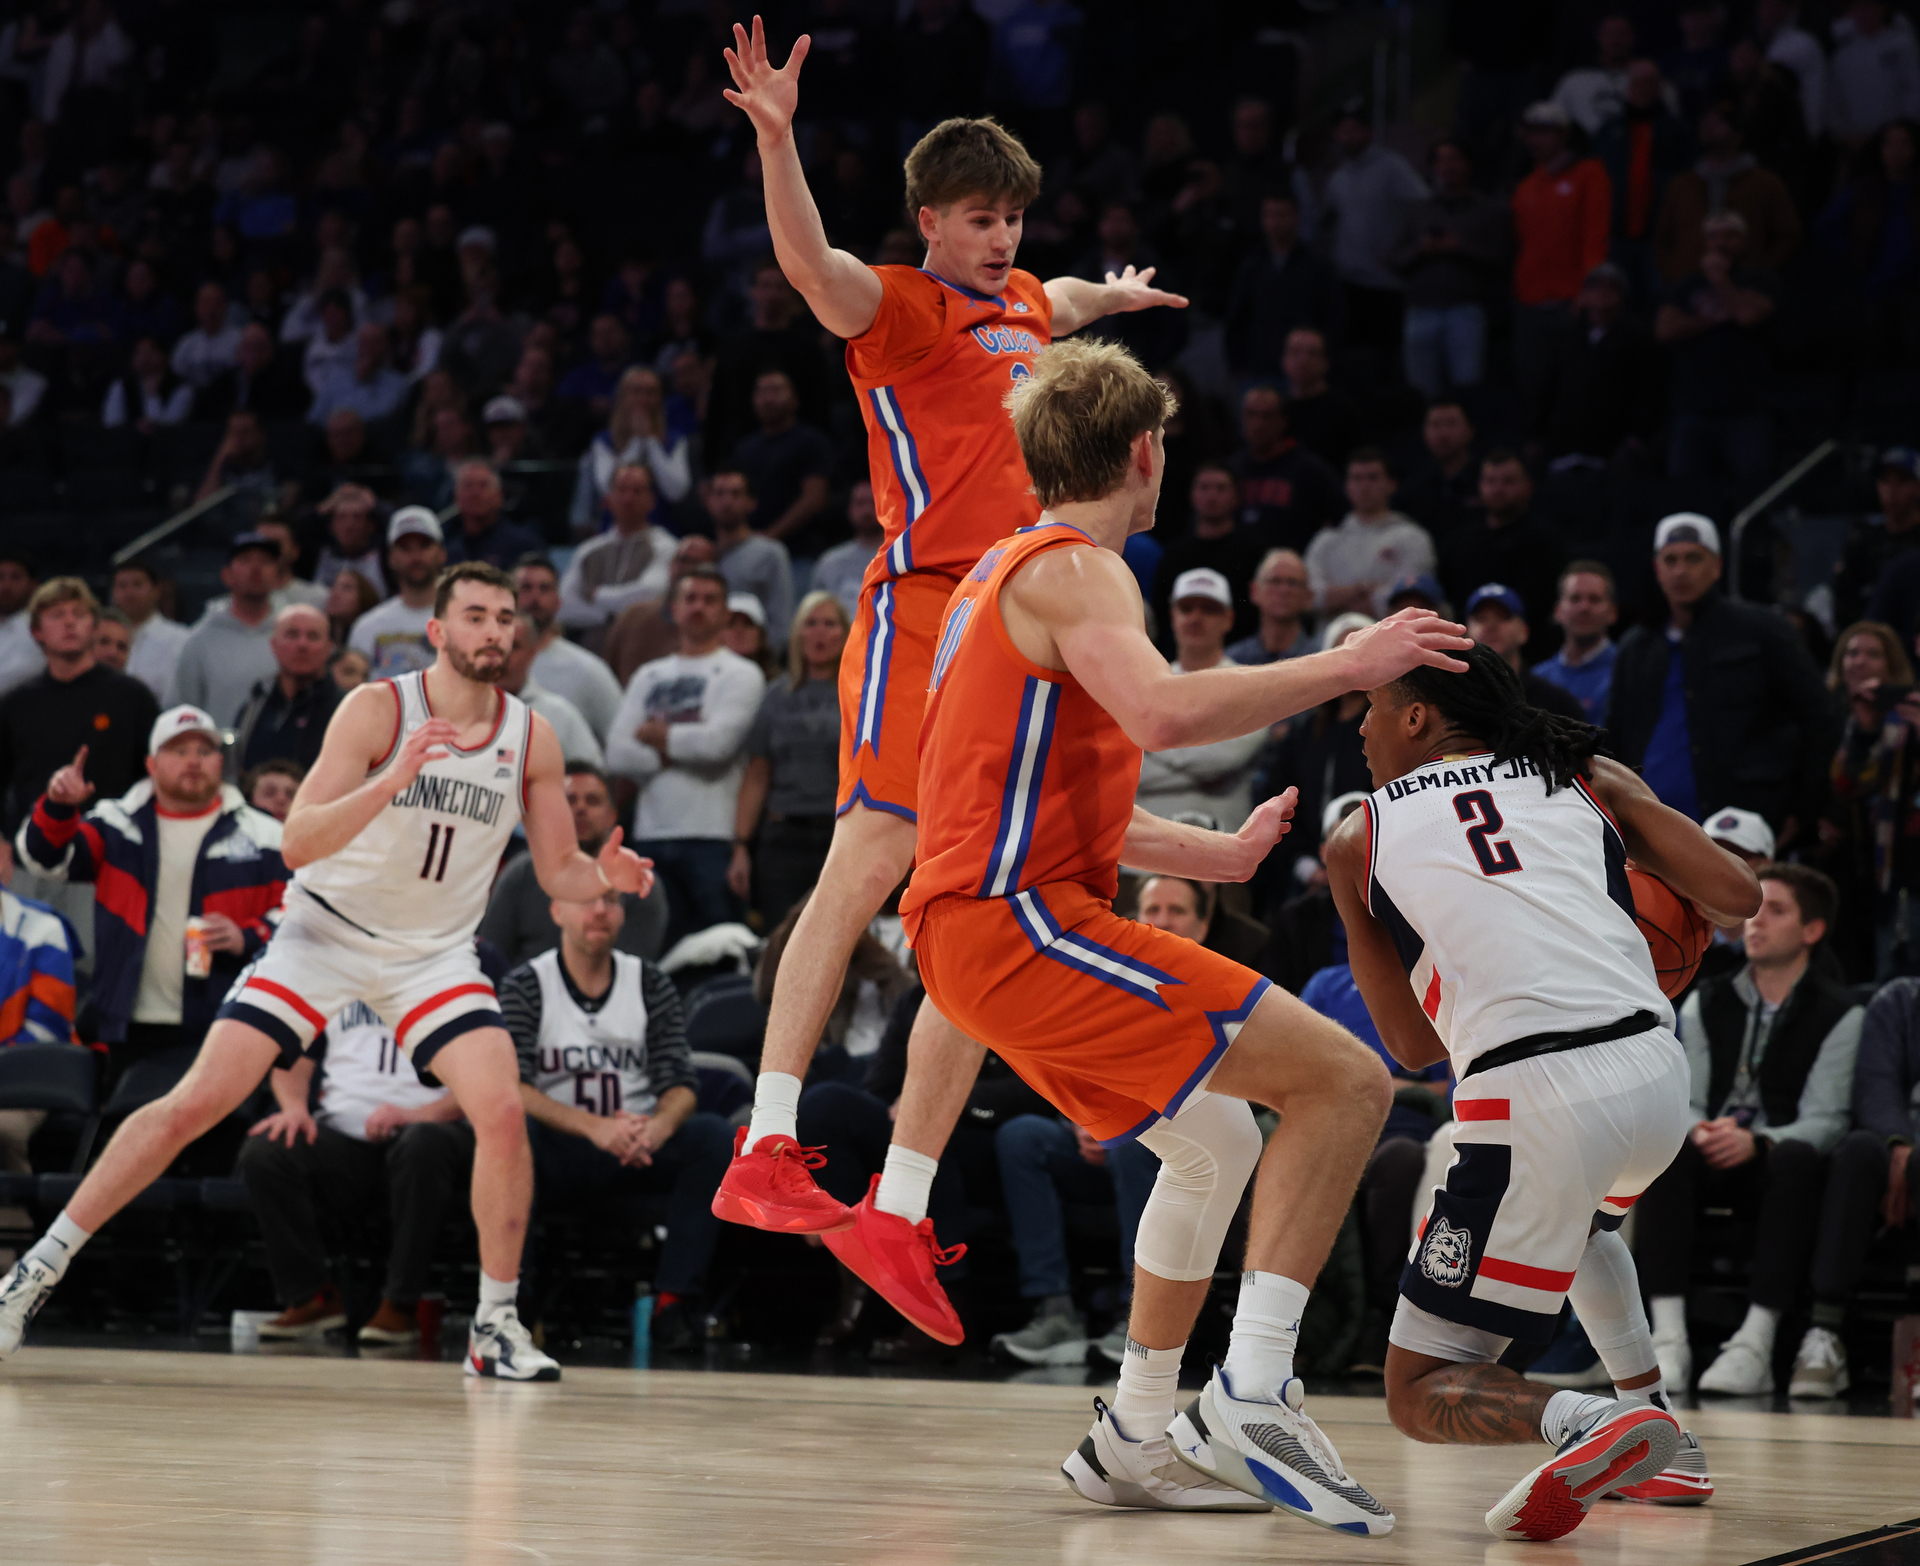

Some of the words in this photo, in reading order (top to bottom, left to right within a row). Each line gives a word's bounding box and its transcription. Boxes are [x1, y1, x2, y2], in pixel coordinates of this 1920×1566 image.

[1384, 763, 1495, 802] DEMARY
[1452, 788, 1524, 877] 2
[420, 823, 455, 883] 11
[378, 1037, 399, 1074] 11
[539, 1045, 646, 1073] UCONN
